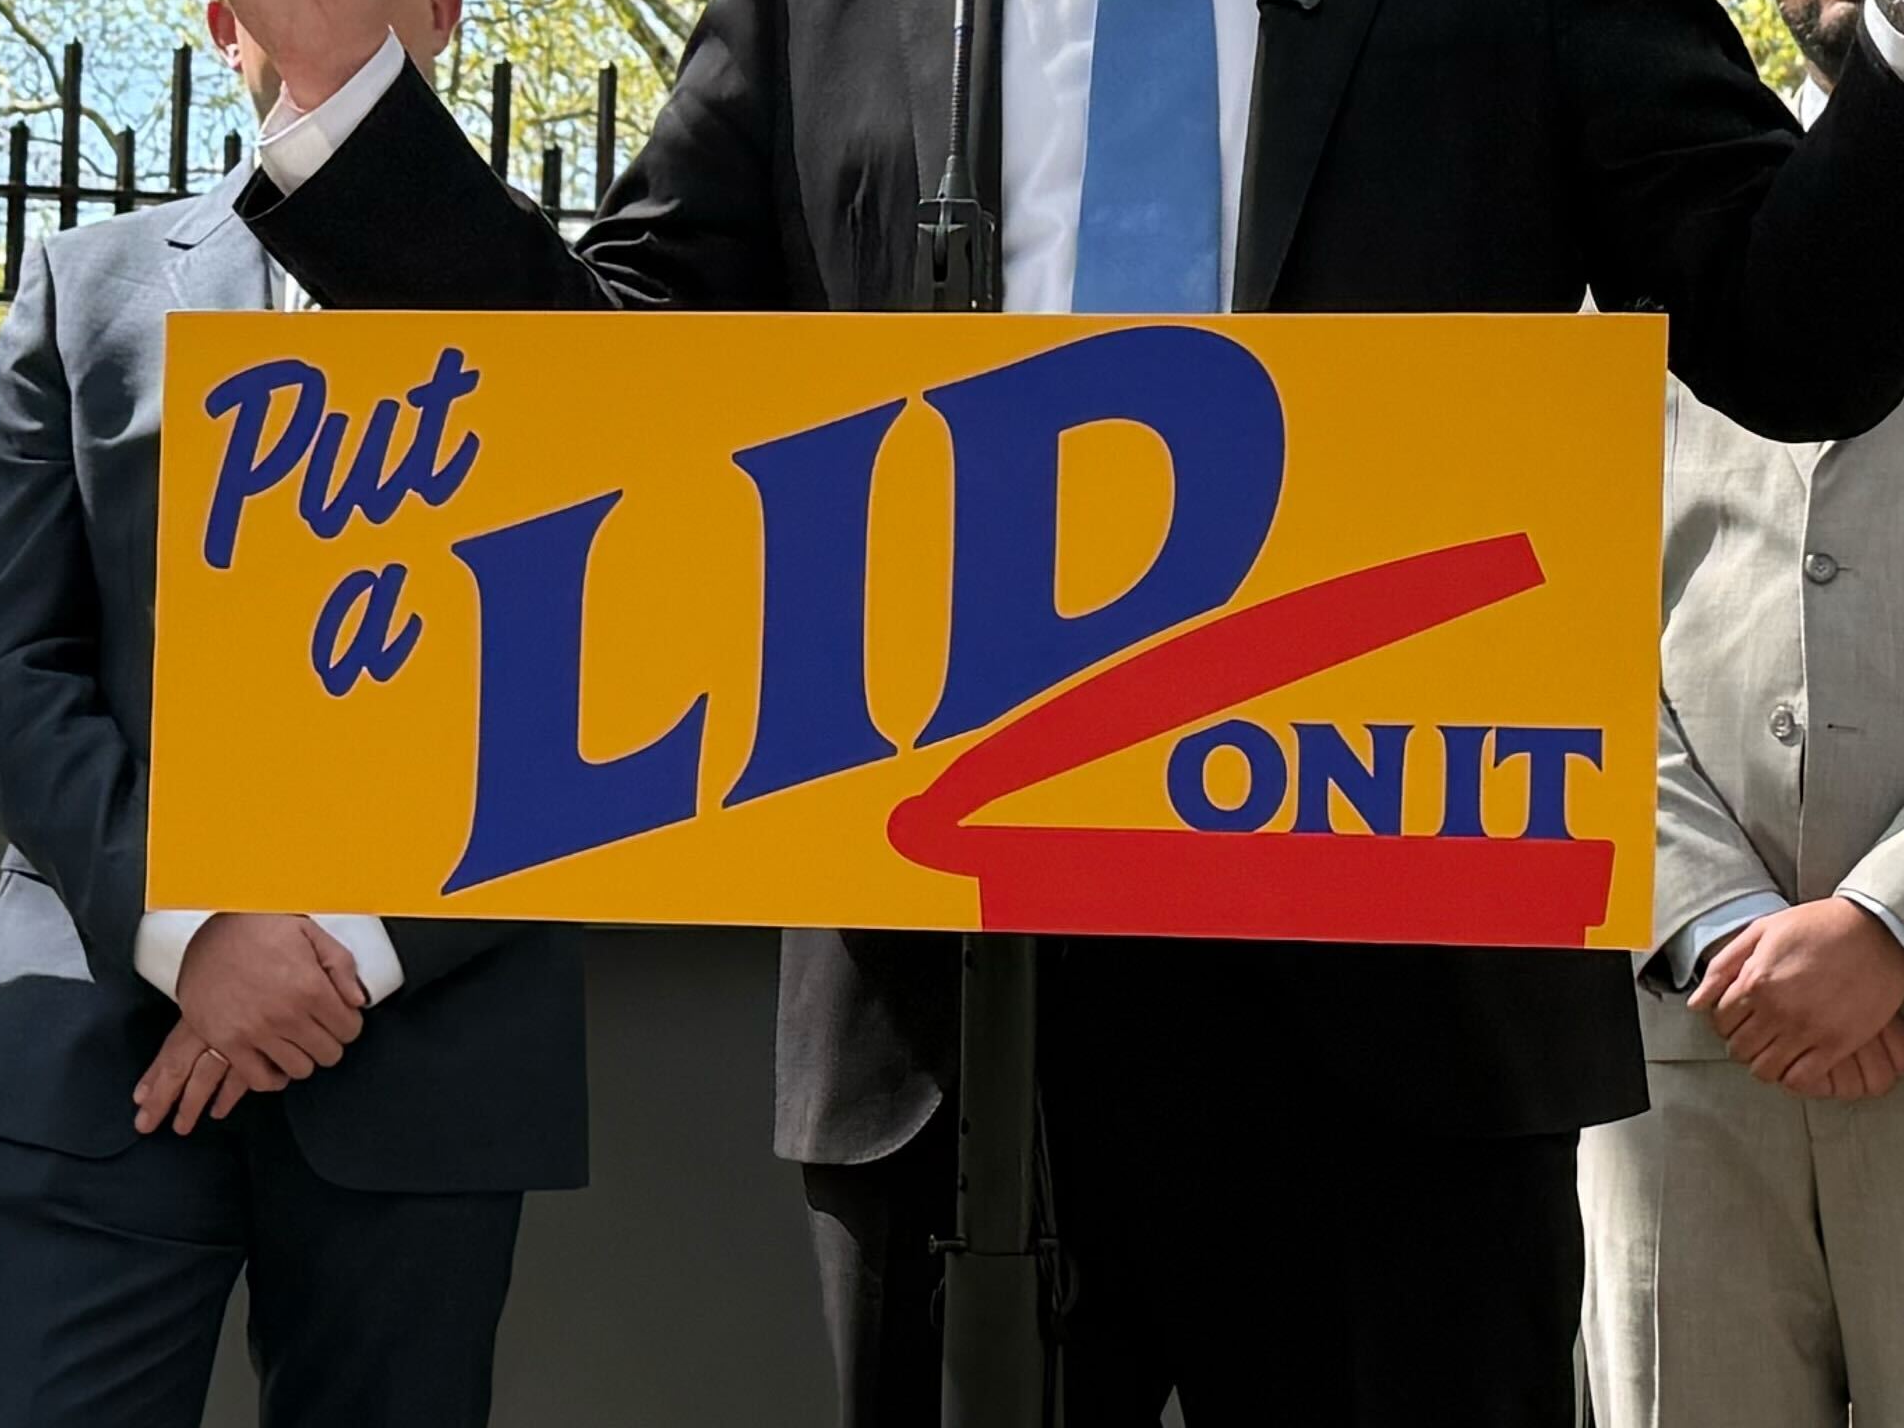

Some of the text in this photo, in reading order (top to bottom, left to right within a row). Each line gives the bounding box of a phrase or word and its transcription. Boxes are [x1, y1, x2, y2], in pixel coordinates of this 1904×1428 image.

[204, 346, 481, 570] Put
[312, 563, 421, 697] a
[442, 325, 1286, 896] LID
[1167, 720, 1603, 839] ON IT
